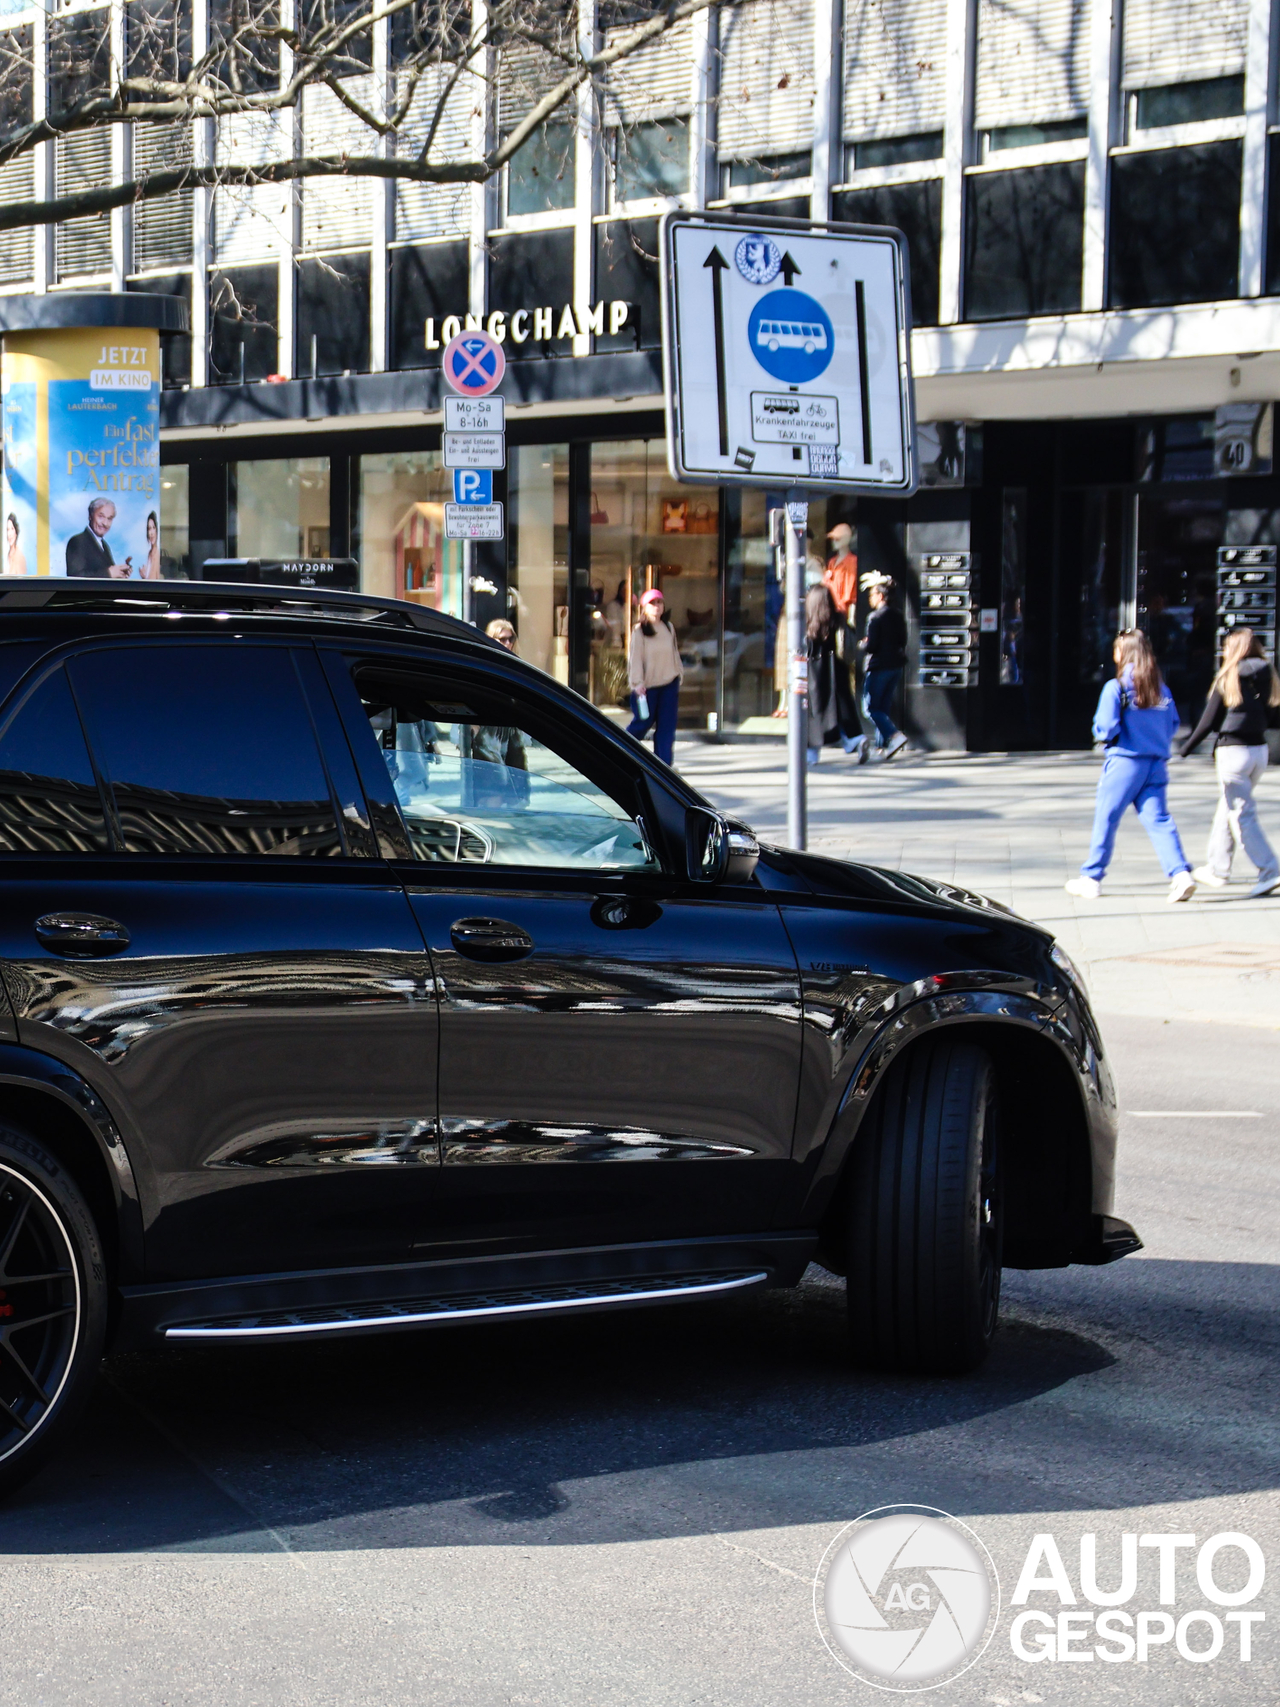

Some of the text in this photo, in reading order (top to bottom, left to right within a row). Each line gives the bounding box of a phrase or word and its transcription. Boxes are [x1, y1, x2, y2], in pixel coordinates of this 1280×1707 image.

[425, 300, 629, 350] LONGCHAMP
[98, 346, 147, 364] JETZT
[95, 373, 149, 386] IM KINO
[68, 403, 118, 411] LAUTERBACH
[456, 401, 492, 412] Mo-Sa
[105, 416, 155, 441] Ein fast
[460, 417, 489, 428] 8-16h
[755, 415, 835, 430] Krankenfahrzeuge
[778, 430, 816, 440] TAXI frei
[83, 469, 154, 499] Antrag
[460, 470, 480, 501] P
